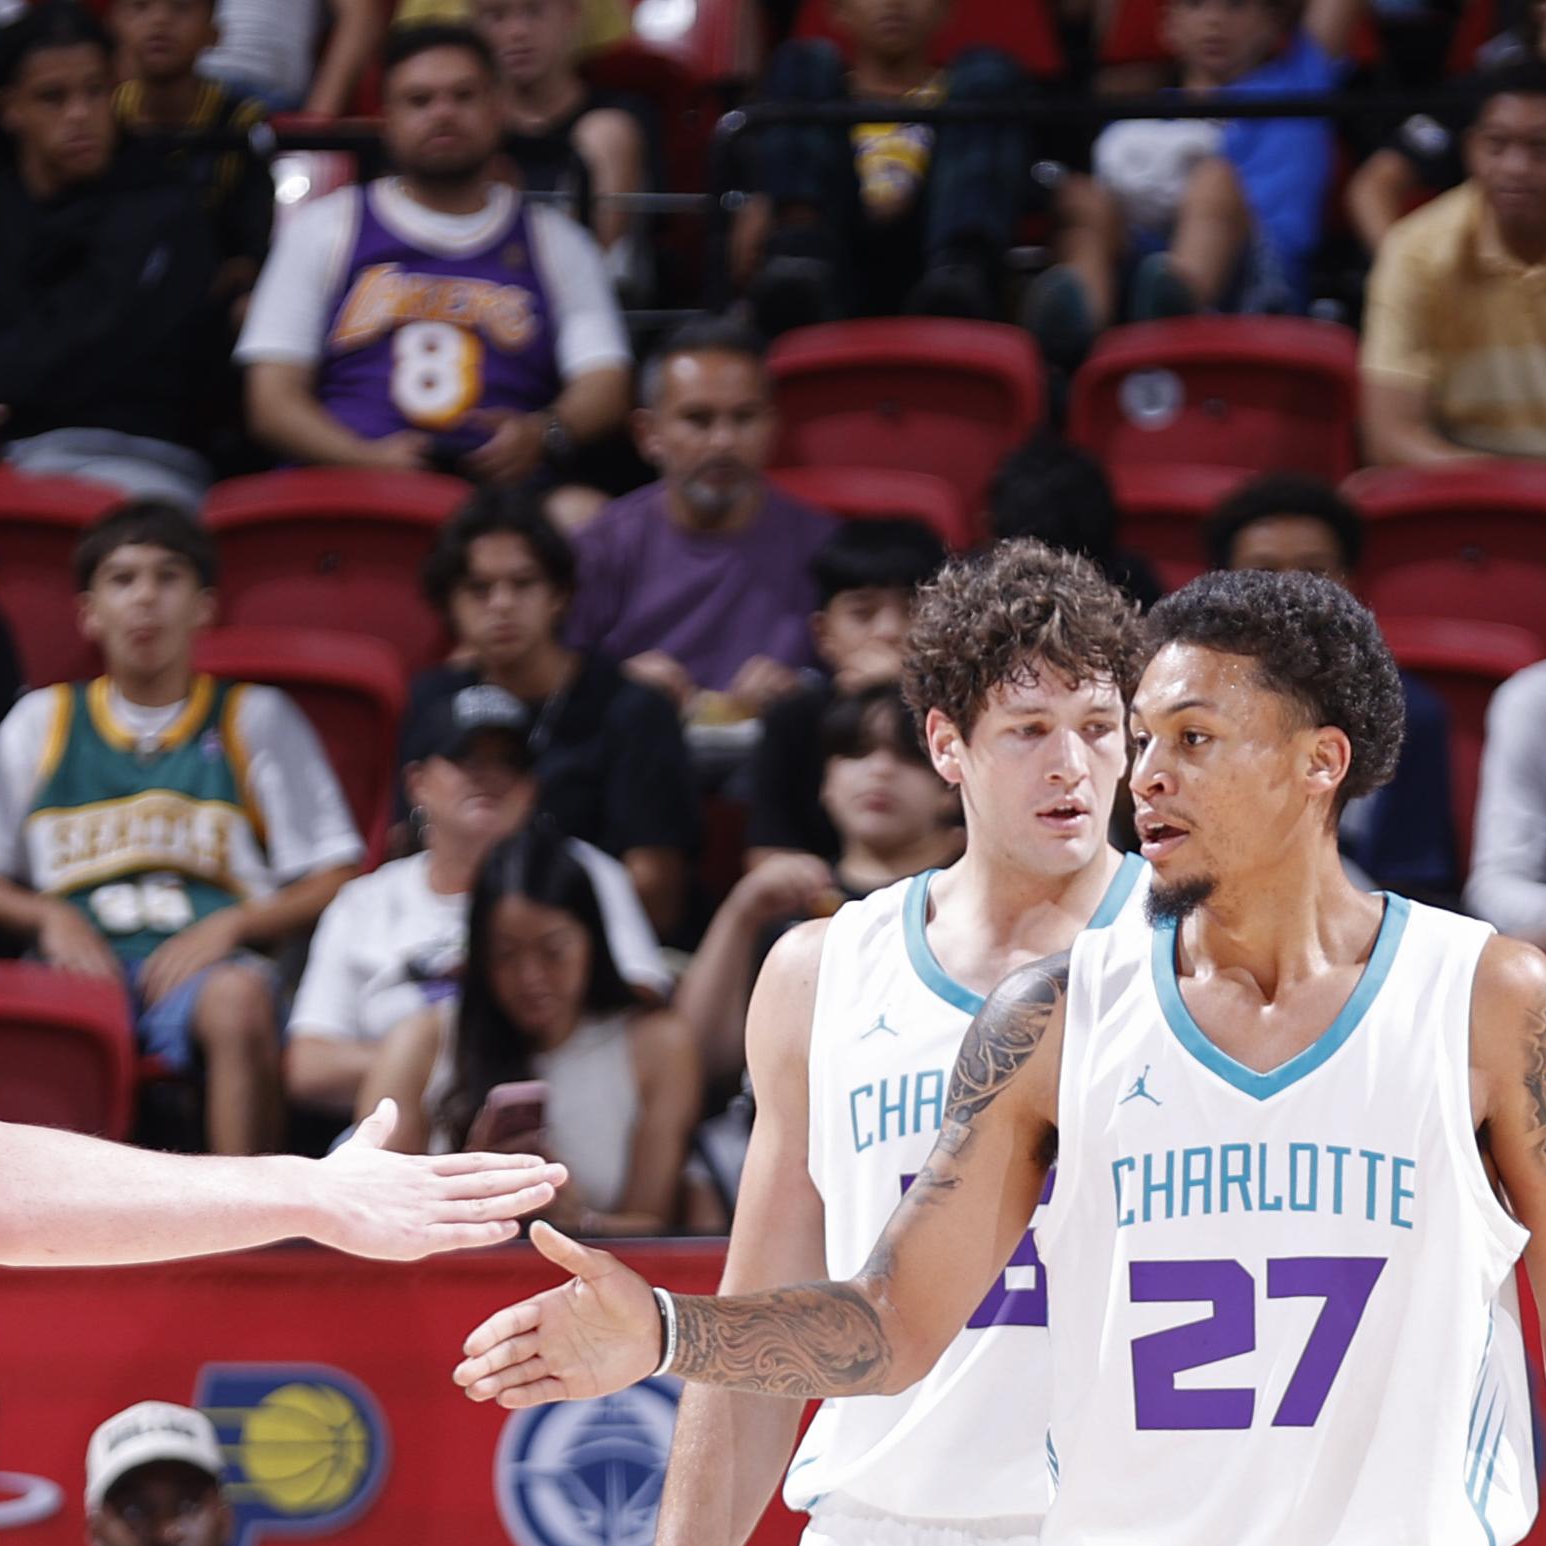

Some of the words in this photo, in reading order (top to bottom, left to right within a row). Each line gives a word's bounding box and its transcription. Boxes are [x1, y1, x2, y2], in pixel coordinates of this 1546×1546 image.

[390, 321, 484, 430] 8
[1112, 1143, 1416, 1230] CHARLOTTE
[1128, 1257, 1388, 1431] 27
